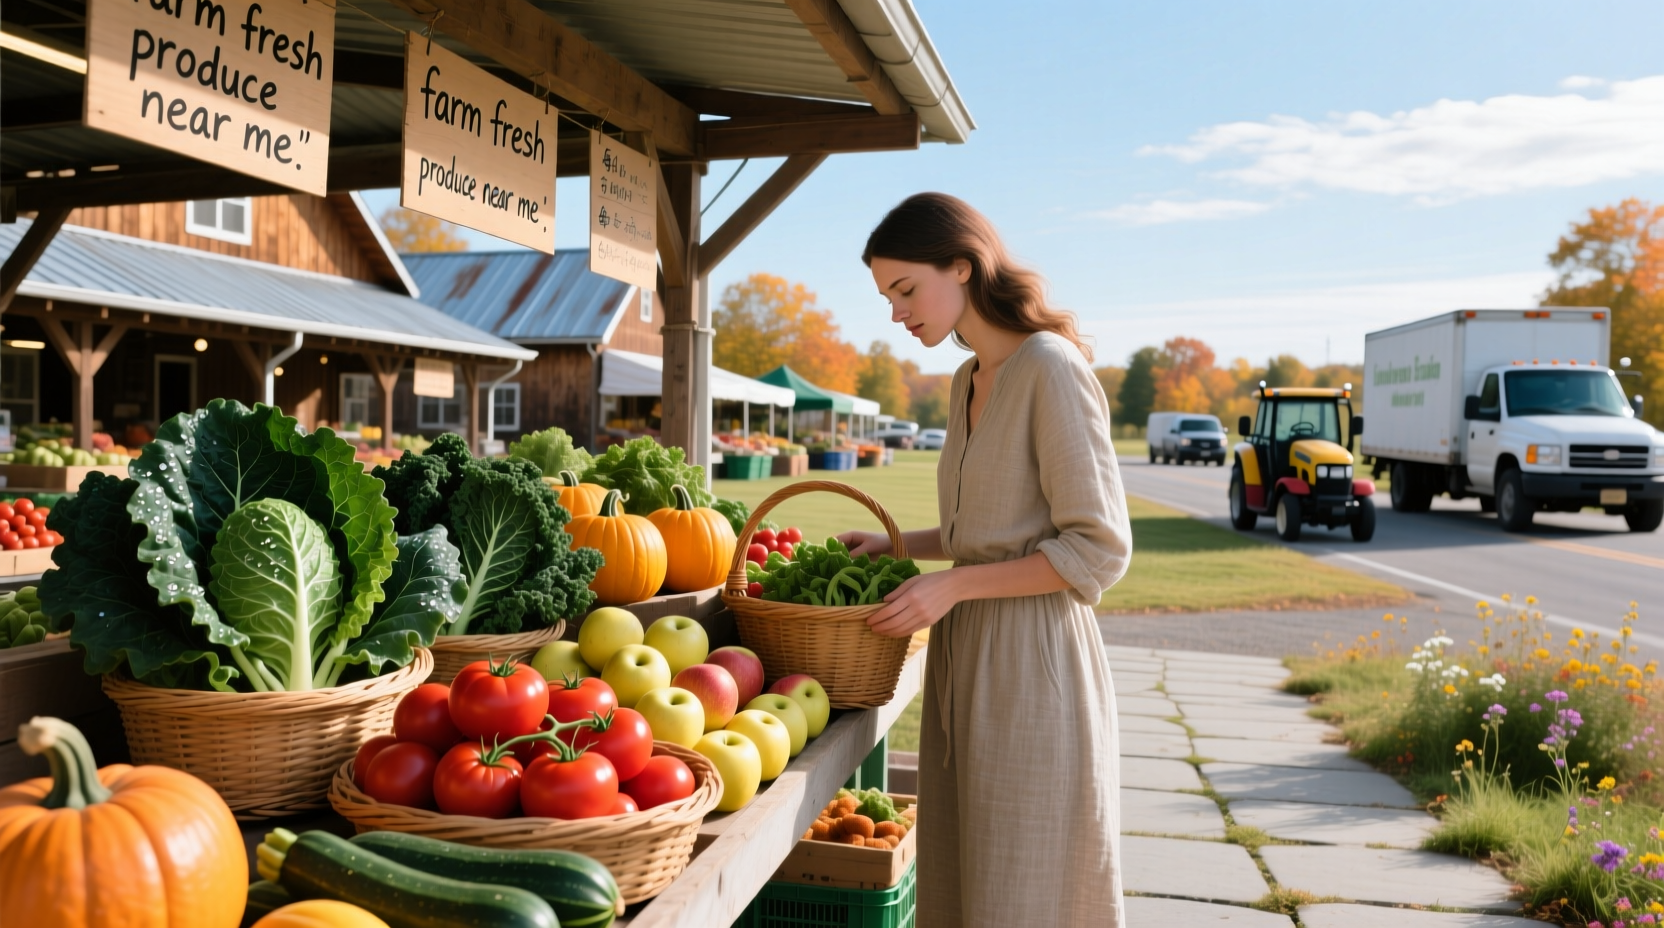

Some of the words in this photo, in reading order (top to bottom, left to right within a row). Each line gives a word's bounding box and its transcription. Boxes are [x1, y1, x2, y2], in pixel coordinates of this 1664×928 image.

[129, 29, 277, 110] produce
[241, 3, 323, 80] fresh
[141, 89, 231, 141] near
[420, 65, 481, 137] farm
[490, 99, 544, 164] fresh
[418, 155, 476, 200] produce
[482, 183, 514, 211] near
